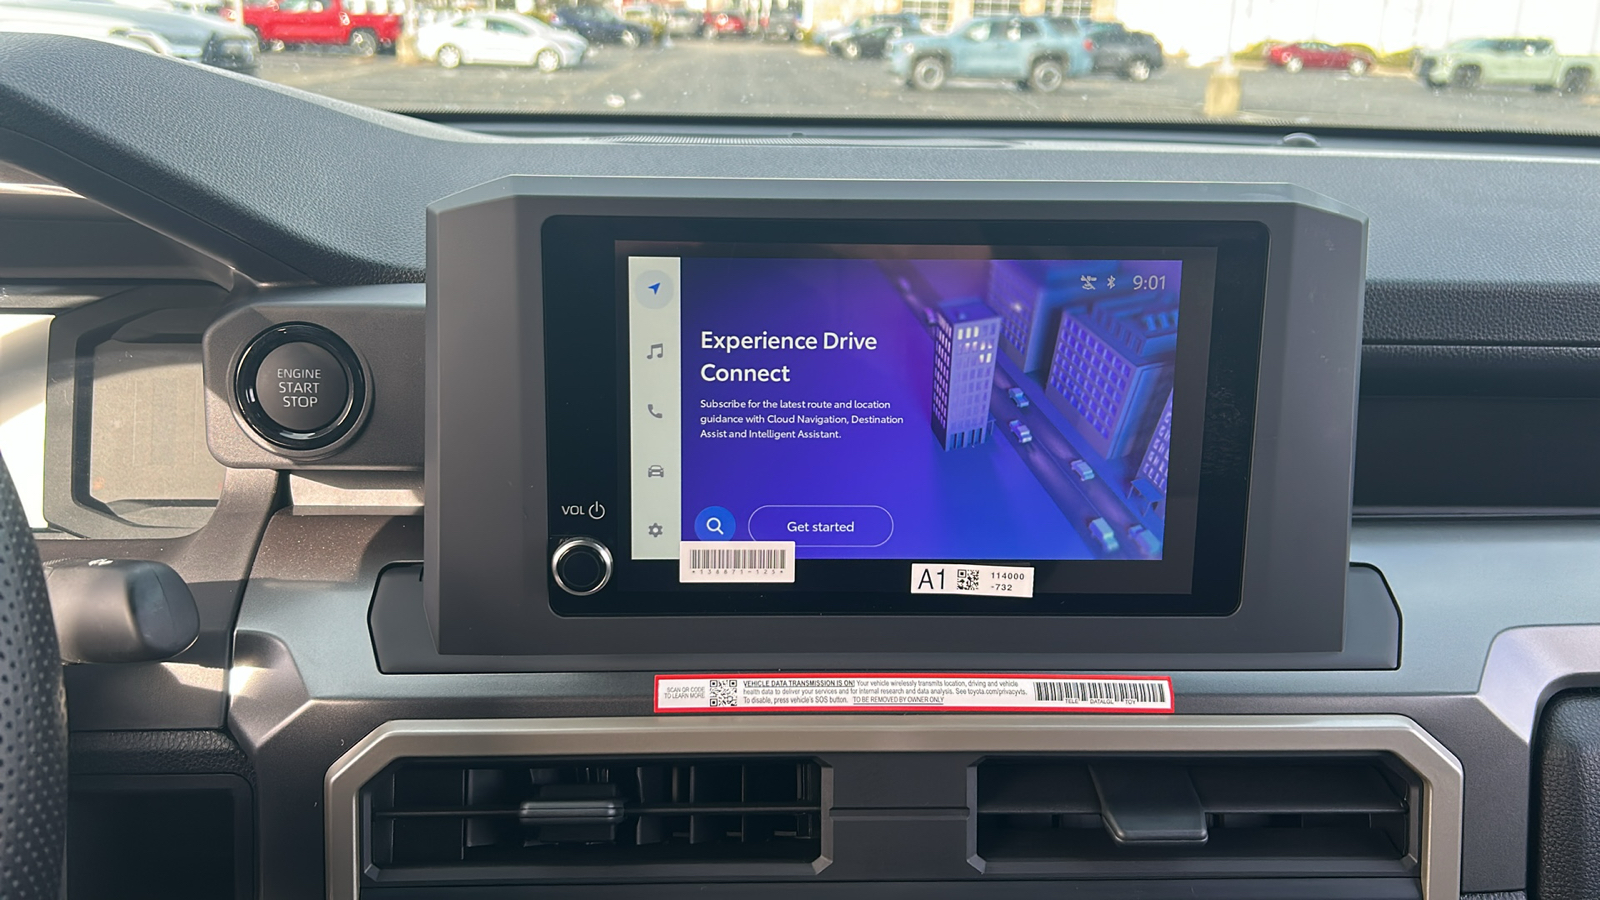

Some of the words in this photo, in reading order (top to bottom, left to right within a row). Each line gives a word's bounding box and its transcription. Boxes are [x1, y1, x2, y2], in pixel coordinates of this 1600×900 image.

[1133, 275, 1166, 290] 9:01
[701, 330, 818, 353] Experience
[823, 331, 878, 350] Drive
[278, 368, 321, 378] ENGINE
[701, 363, 790, 382] Connect
[279, 382, 320, 393] START
[283, 396, 318, 408] STOP
[700, 400, 746, 409] Subscribe
[748, 400, 761, 409] for
[763, 400, 778, 409] the
[780, 400, 806, 409] latest
[834, 400, 852, 409] and
[854, 400, 891, 409] location
[700, 415, 744, 425] guidance
[746, 415, 764, 423] with
[767, 415, 795, 424] Cloud
[797, 415, 849, 425] Navigation,
[851, 415, 904, 424] Destination
[700, 430, 727, 438] Assist
[729, 430, 746, 438] and
[749, 430, 796, 440] Intelligent
[797, 430, 842, 439] Assistant.
[561, 505, 585, 515] VOL
[787, 521, 809, 532] Get
[812, 521, 855, 532] started
[918, 568, 944, 589] A1
[991, 572, 1024, 580] 114000
